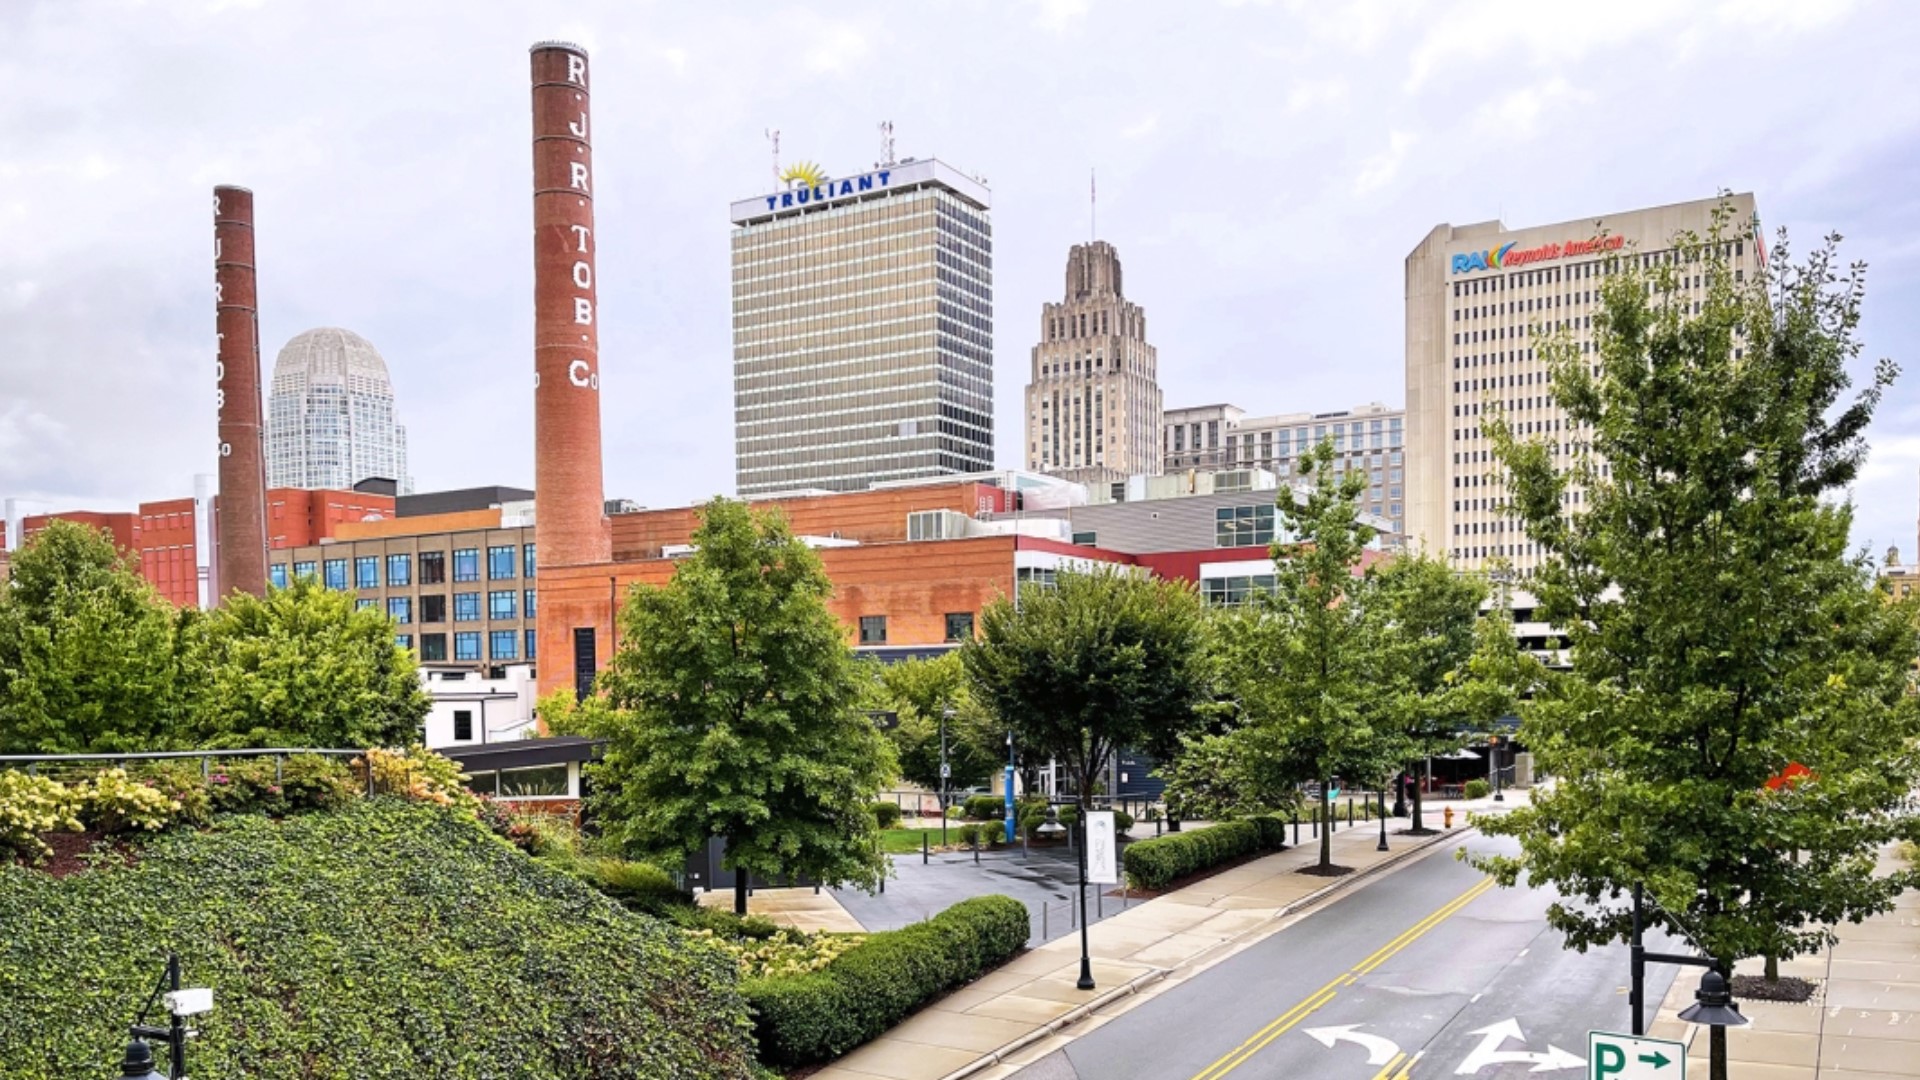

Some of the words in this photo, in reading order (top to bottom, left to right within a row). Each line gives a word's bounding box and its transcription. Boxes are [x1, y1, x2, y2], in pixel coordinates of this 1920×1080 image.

[767, 171, 890, 210] TRULIANT
[1503, 243, 1560, 267] Reynolds
[1563, 235, 1624, 257] American
[1596, 1043, 1626, 1080] P
